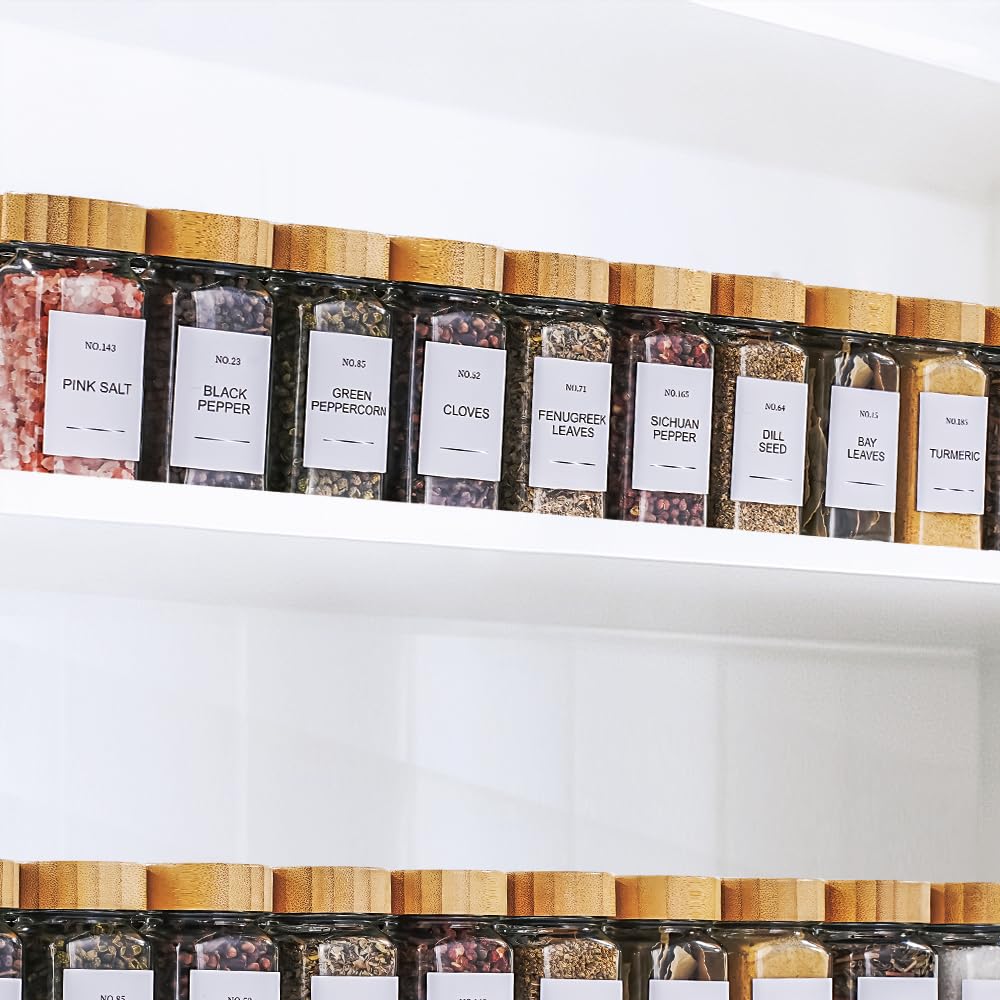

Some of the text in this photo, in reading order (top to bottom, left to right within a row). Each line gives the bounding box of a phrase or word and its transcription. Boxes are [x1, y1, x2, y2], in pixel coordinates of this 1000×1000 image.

[85, 341, 116, 352] NO.143
[216, 355, 241, 365] NO.23
[342, 358, 366, 368] NO.85
[63, 379, 132, 395] PINK SALT
[204, 385, 247, 400] BLACK
[332, 388, 372, 401] GREEN
[198, 400, 250, 415] PEPPER
[311, 401, 386, 416] PEPPERCORN
[443, 404, 489, 419] CLOVES
[765, 403, 785, 411] NO.64
[539, 410, 606, 425] FENUGREEK
[651, 416, 699, 429] SICHUAN
[552, 425, 594, 438] LEAVES
[653, 430, 696, 442] PEPPER
[763, 430, 784, 441] DILL
[759, 442, 787, 454] SEED
[858, 437, 877, 447] BAY
[848, 449, 885, 461] LEAVES
[929, 449, 980, 461] TURMERIC
